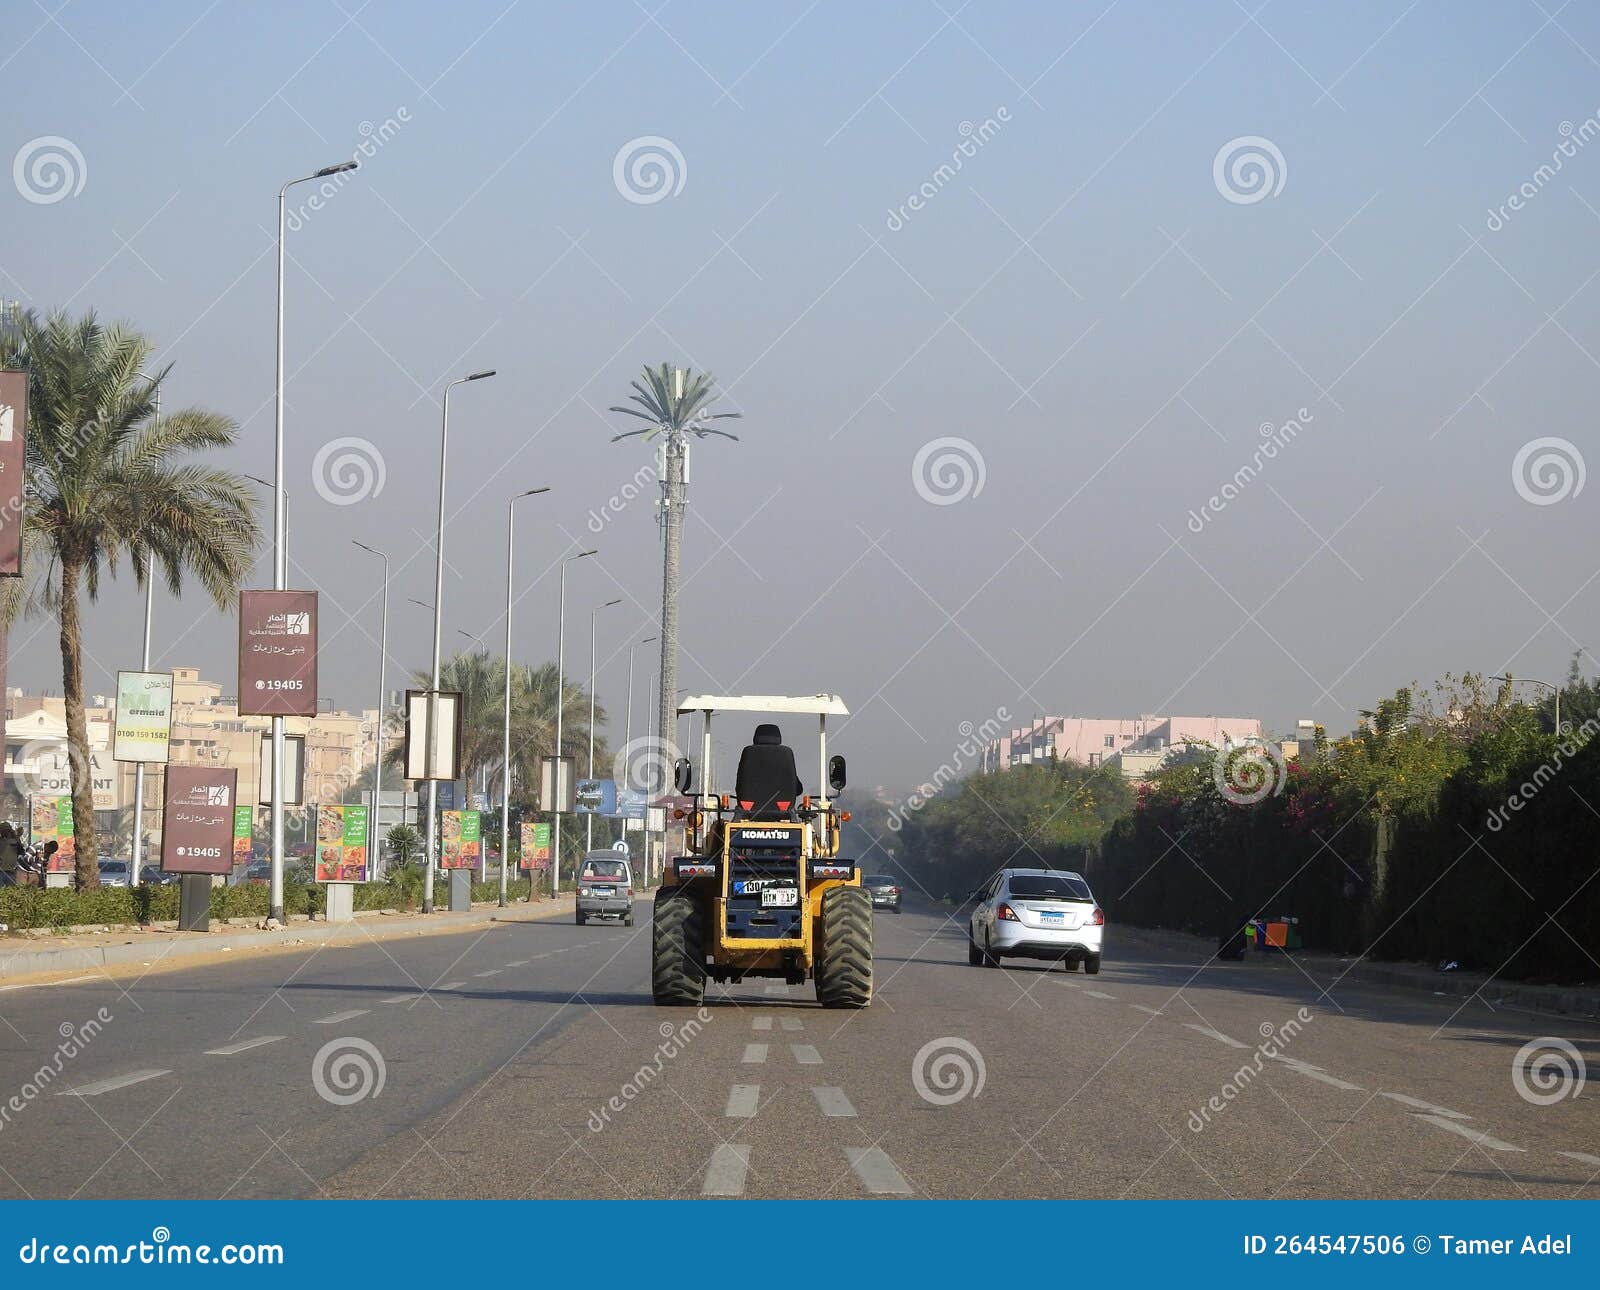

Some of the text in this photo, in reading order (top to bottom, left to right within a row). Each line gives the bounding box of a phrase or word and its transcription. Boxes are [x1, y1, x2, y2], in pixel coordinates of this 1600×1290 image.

[267, 680, 303, 690] 19405
[742, 830, 790, 840] KOMATSU
[187, 847, 221, 857] 19405
